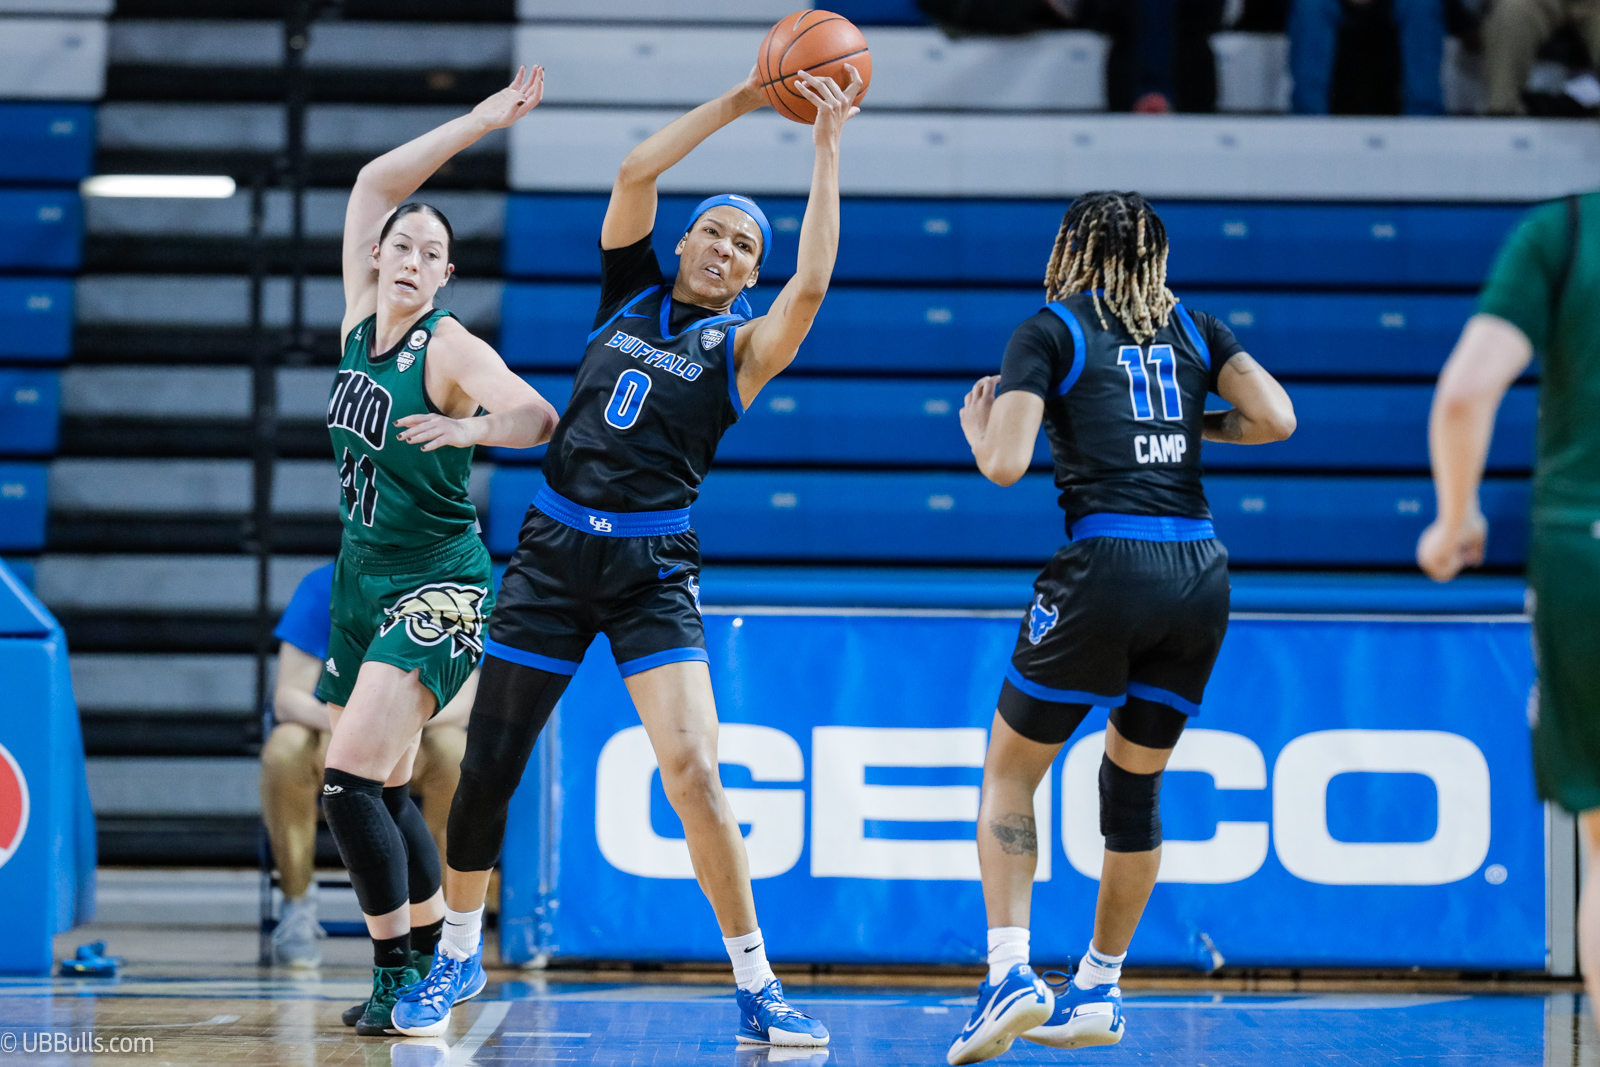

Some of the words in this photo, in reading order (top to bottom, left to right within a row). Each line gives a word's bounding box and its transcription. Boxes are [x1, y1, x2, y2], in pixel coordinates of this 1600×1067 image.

[604, 330, 703, 382] BUFFALO
[1117, 344, 1183, 421] 11
[604, 369, 652, 430] 0
[1133, 434, 1187, 464] CAMP
[339, 446, 379, 528] 41
[588, 515, 612, 533] UB
[595, 722, 1491, 886] GECO
